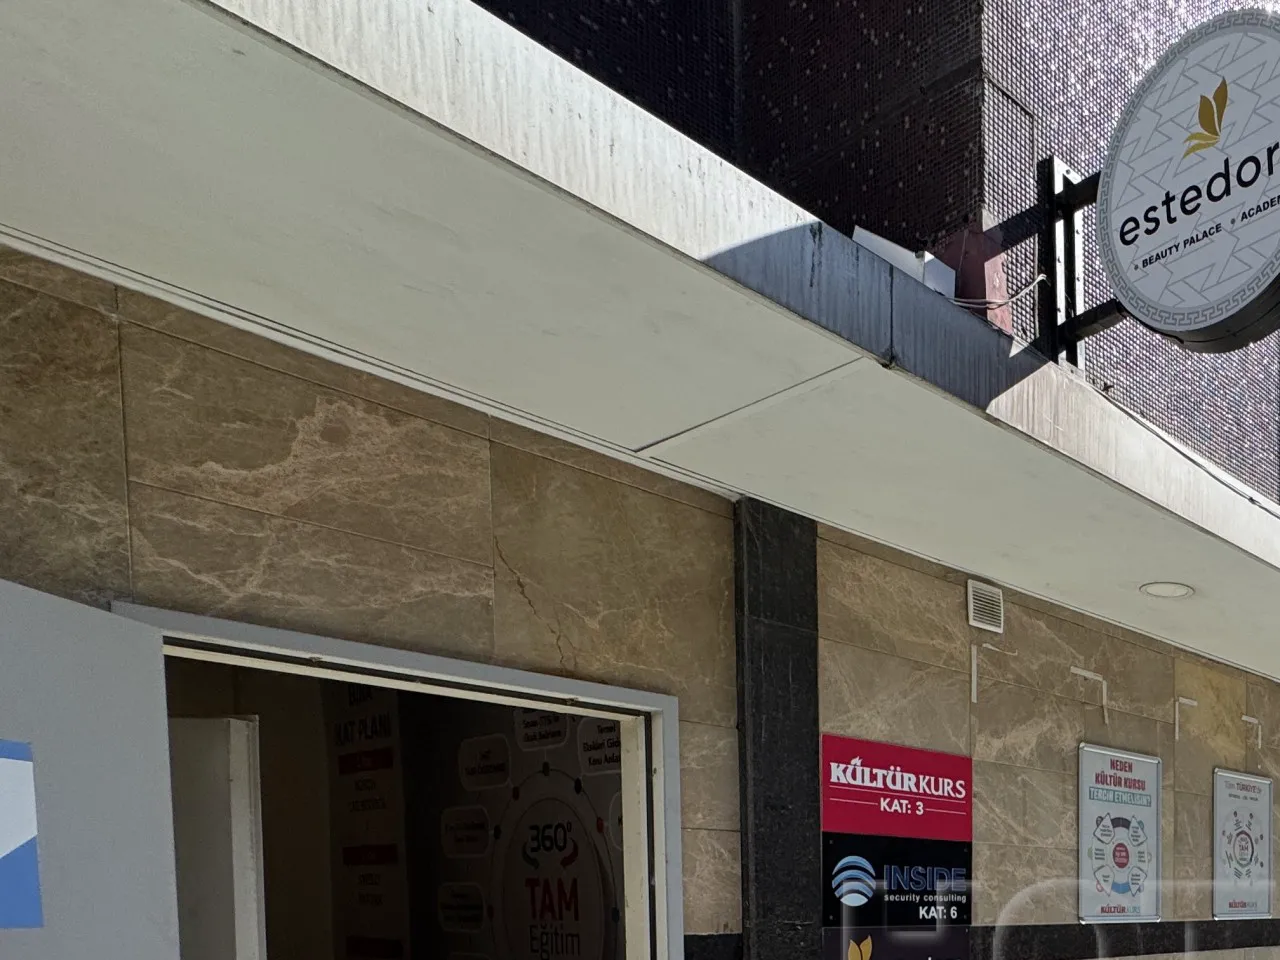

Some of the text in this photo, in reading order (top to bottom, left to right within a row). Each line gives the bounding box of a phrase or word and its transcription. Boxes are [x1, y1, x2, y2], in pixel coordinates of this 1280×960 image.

[1141, 242, 1181, 269] BEAUTY
[1183, 223, 1223, 250] PALACE
[1110, 758, 1133, 773] NEDEN
[1095, 770, 1146, 791] KÜLTÜR KURSU
[880, 797, 924, 815] KAT: 3
[883, 864, 967, 893] INSIDE
[525, 877, 579, 921] TAM
[884, 893, 967, 904] security consulting
[919, 905, 958, 919] KAT: 6
